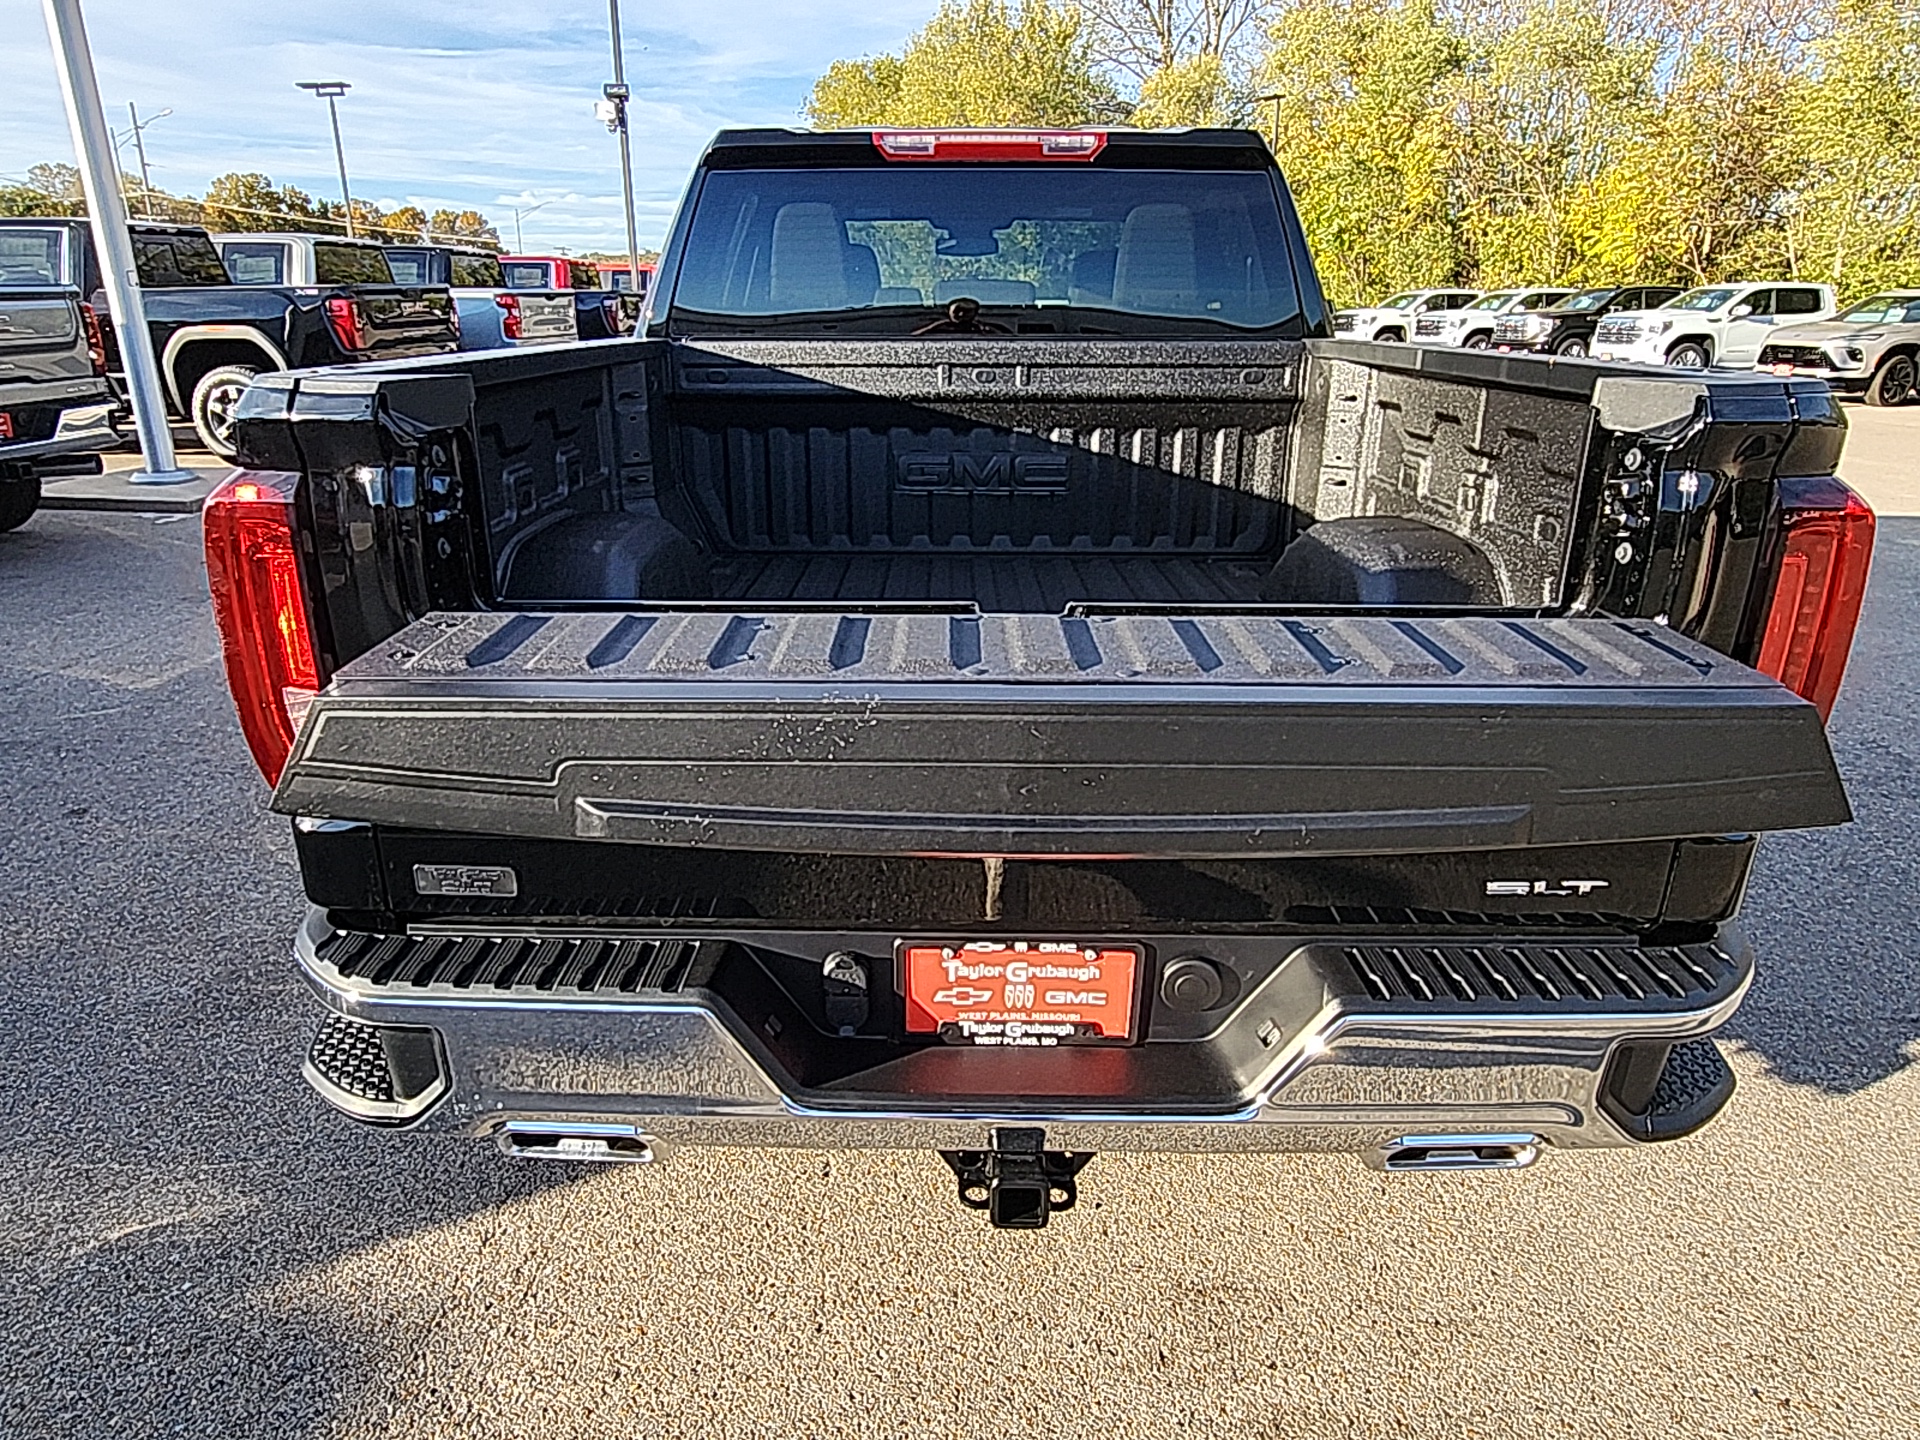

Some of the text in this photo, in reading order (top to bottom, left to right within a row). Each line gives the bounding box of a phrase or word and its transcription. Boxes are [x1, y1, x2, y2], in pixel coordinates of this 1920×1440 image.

[898, 454, 1067, 491] GMC
[1486, 880, 1609, 896] SLT
[1038, 942, 1077, 953] GMC
[942, 961, 1101, 983] Taylor Grubaugh
[1045, 990, 1107, 1005] GMC
[957, 1012, 988, 1021] WEST
[958, 1021, 1075, 1037] Taylor Grubaugh
[974, 1036, 1002, 1045] WEST
